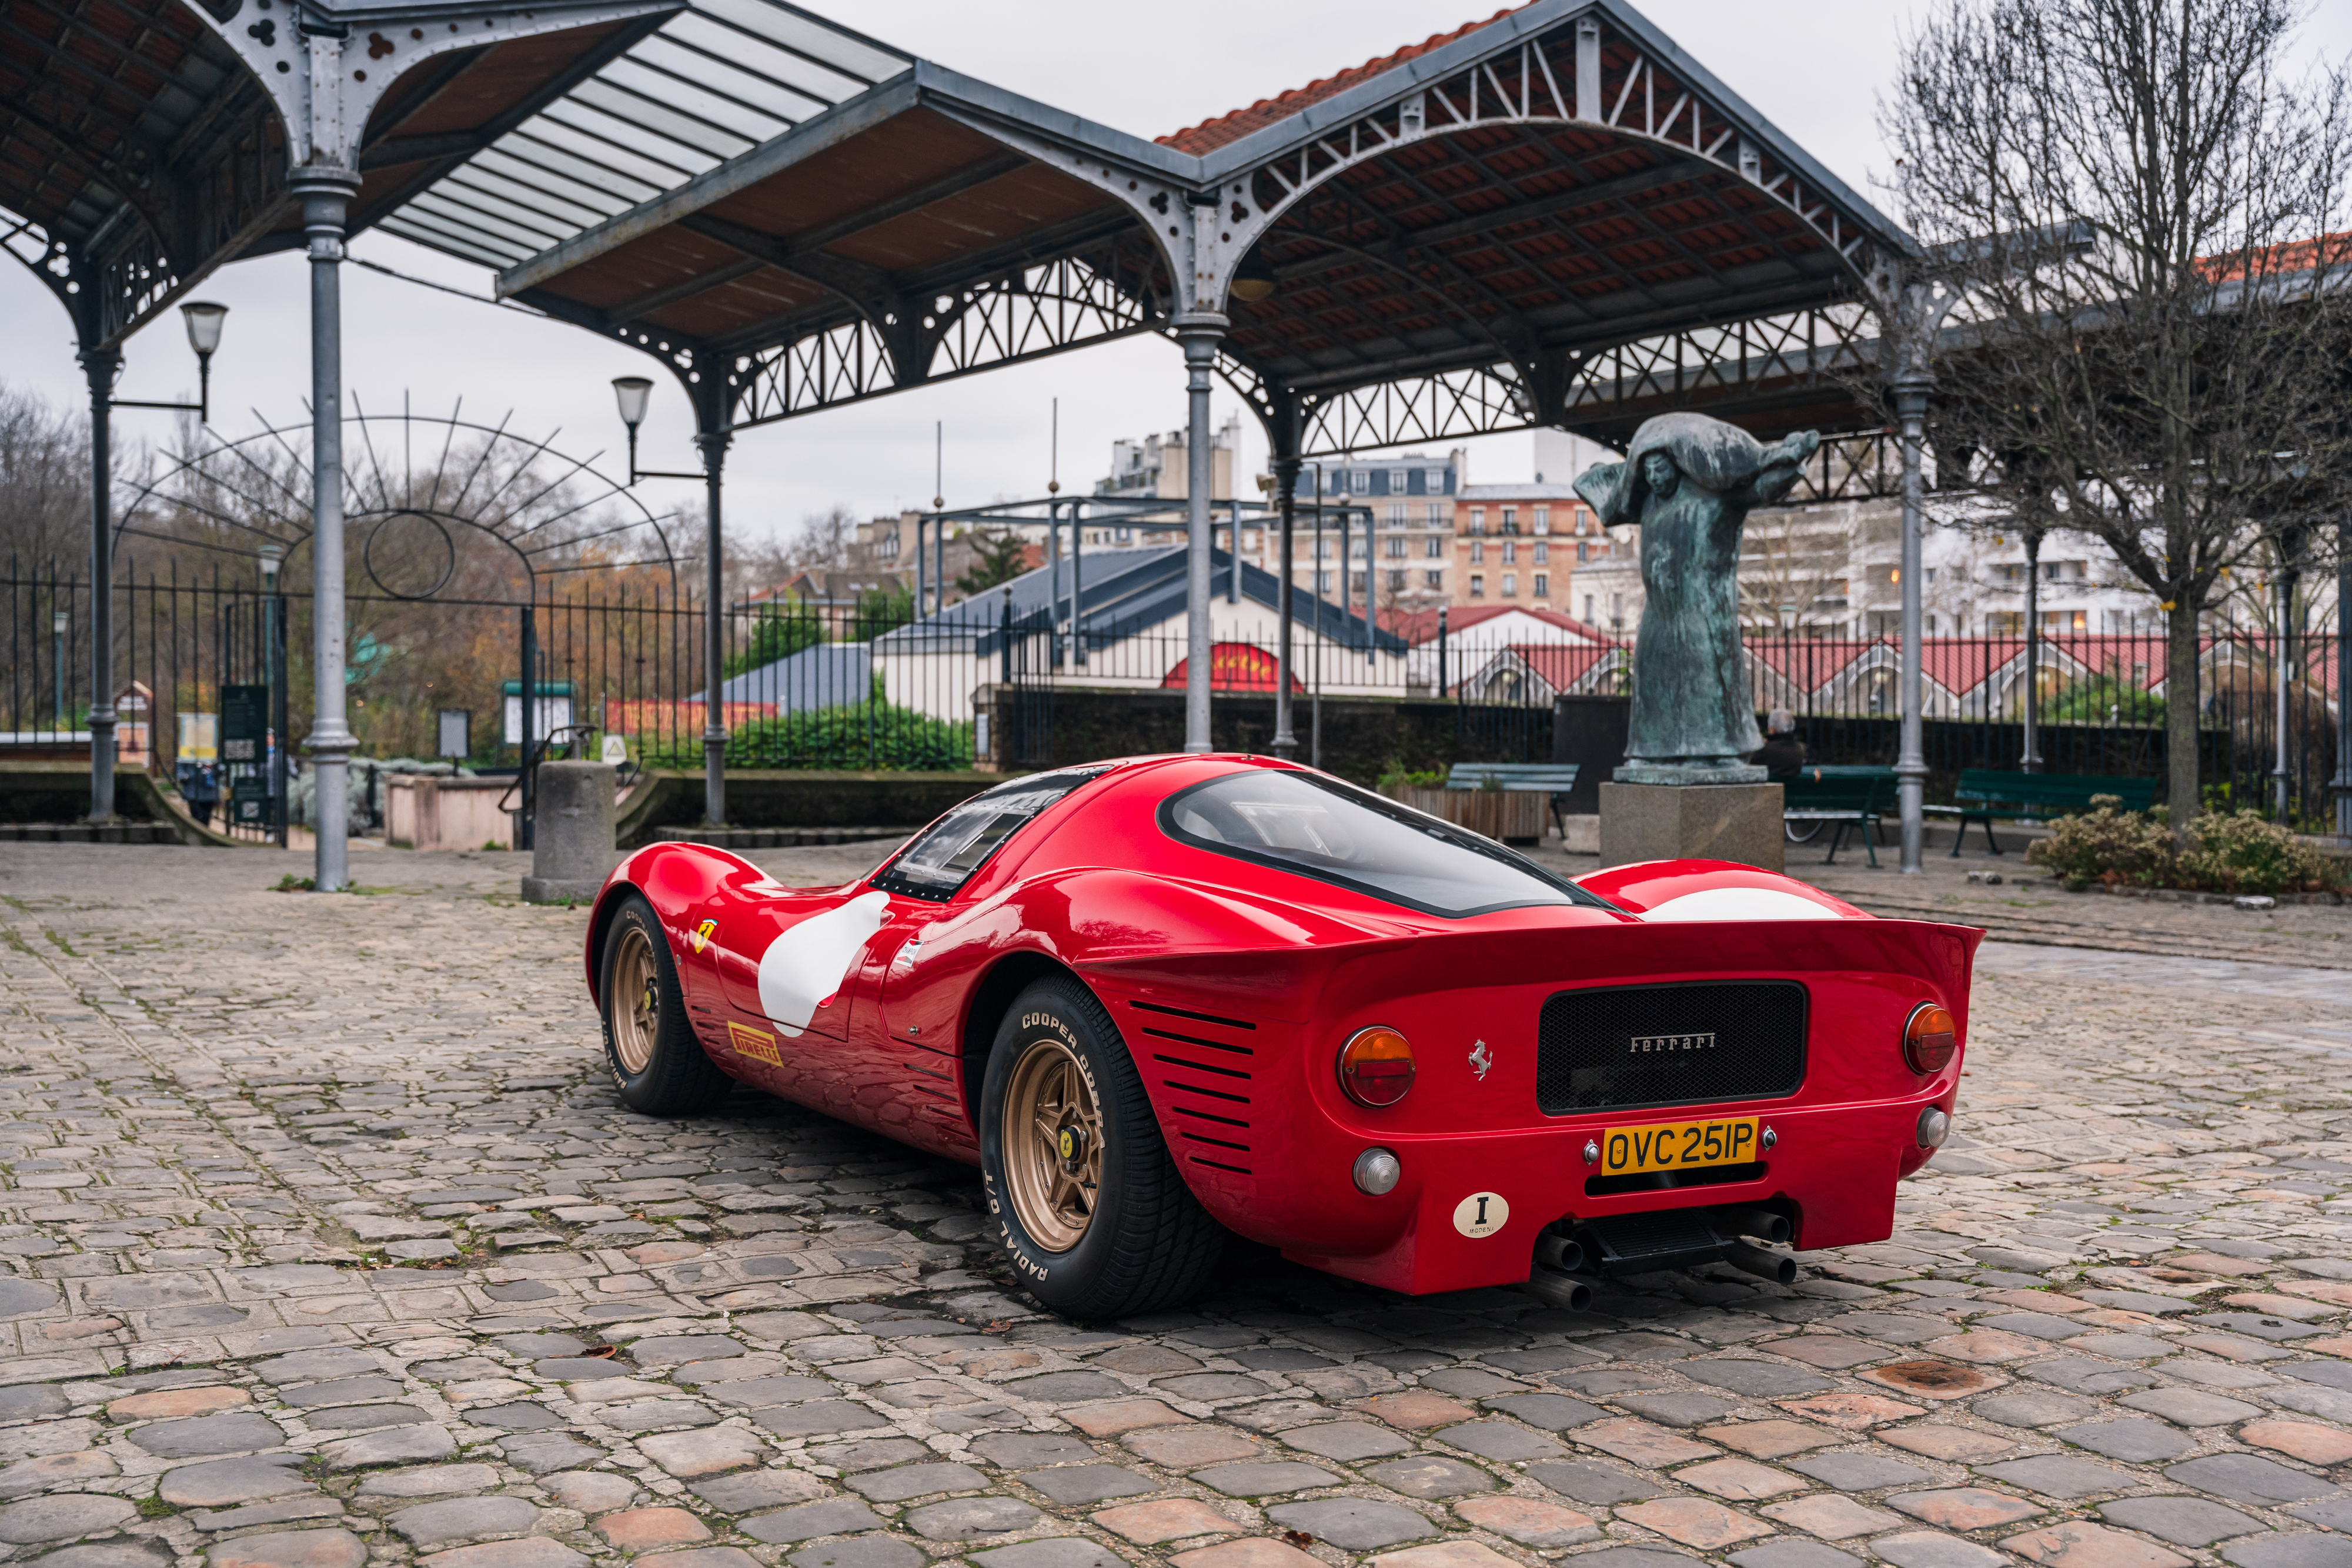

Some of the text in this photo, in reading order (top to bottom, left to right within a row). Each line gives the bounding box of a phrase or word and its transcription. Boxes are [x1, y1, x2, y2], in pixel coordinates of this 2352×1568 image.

[731, 1027, 779, 1062] PIRELLI
[1631, 1032, 1715, 1052] Ferrari
[607, 1049, 627, 1089] RADIAL
[1023, 1012, 1105, 1149] COOPER COBRA
[1608, 1129, 1675, 1169] OVC
[984, 1169, 1049, 1282] RADIAL G/T
[1475, 1196, 1489, 1225] I
